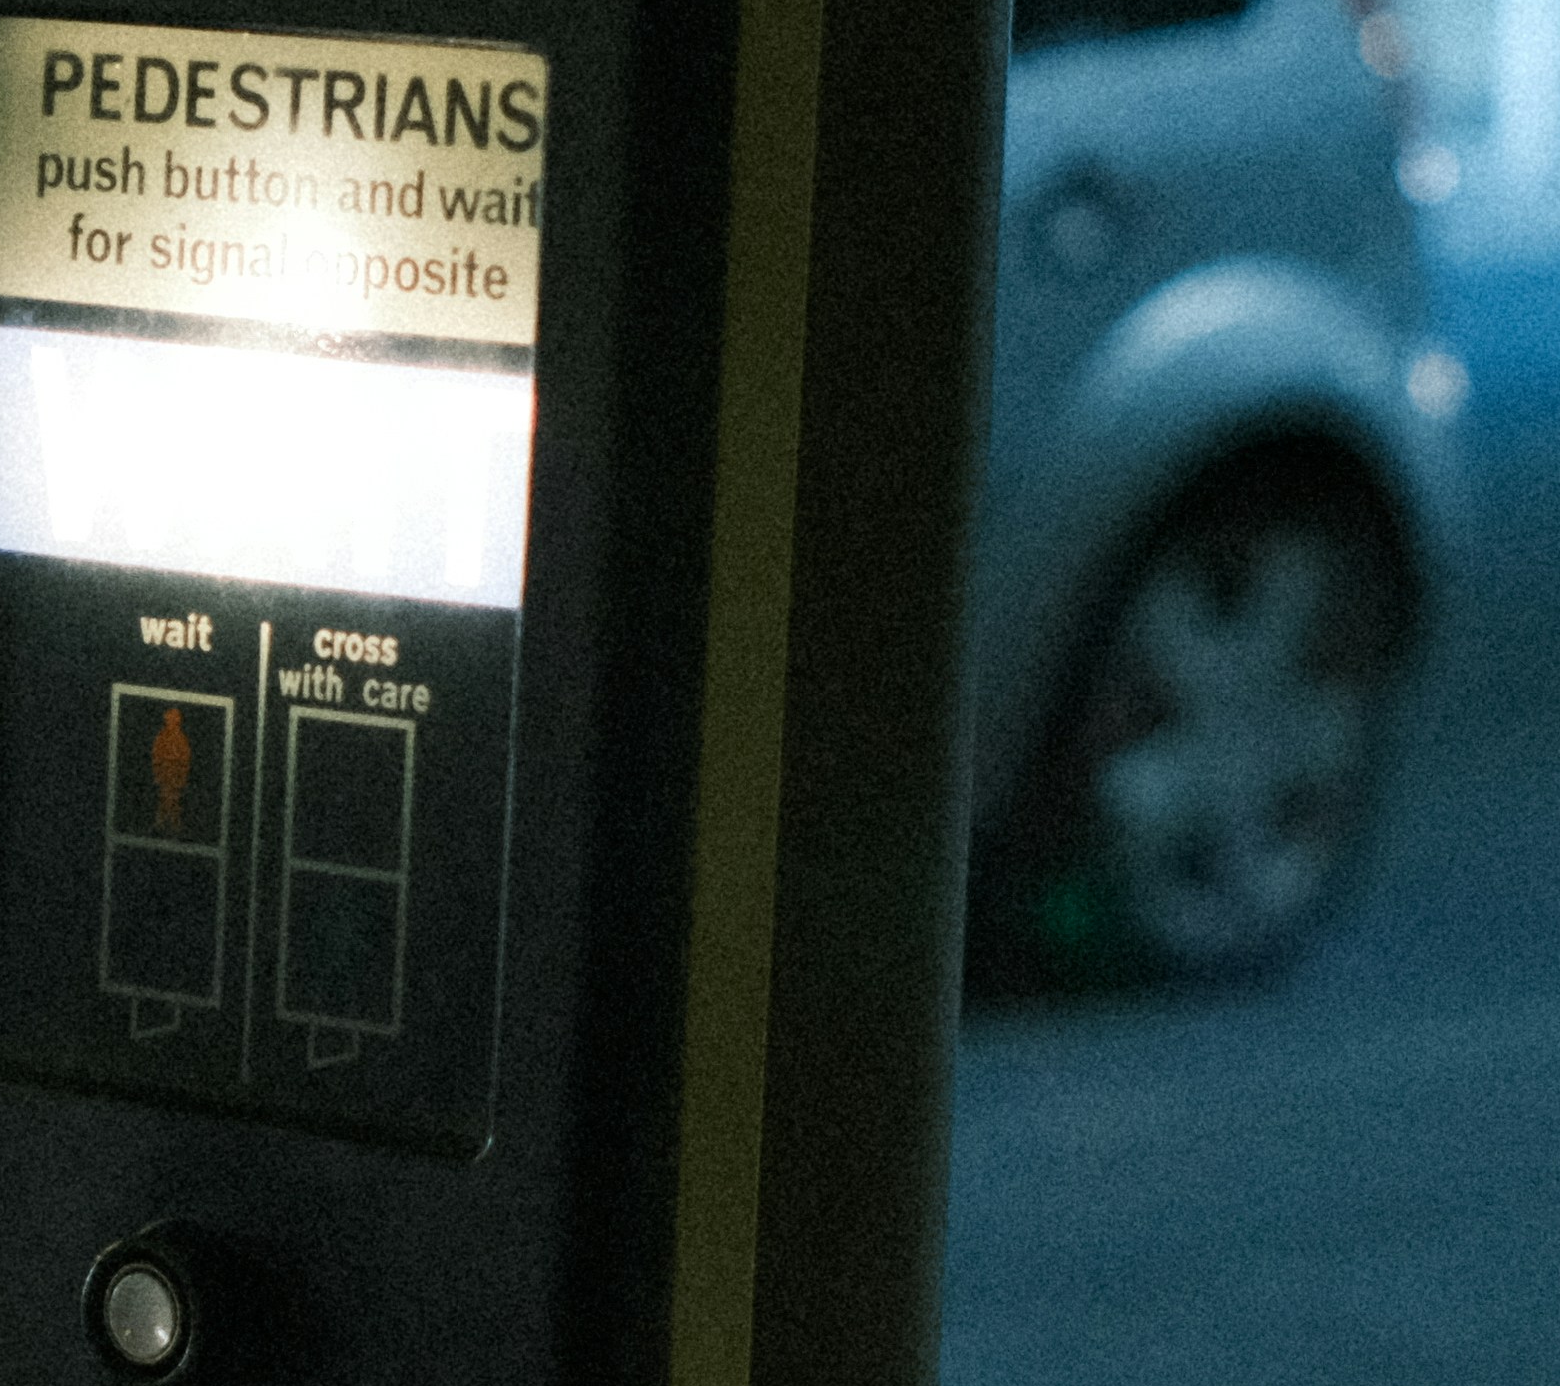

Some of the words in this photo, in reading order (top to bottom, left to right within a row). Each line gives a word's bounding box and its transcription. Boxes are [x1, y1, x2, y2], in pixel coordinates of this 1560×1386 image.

[42, 50, 541, 153] PEDESTRIANS
[37, 146, 144, 198] push
[164, 151, 319, 209] button
[338, 171, 425, 219] and
[440, 176, 540, 227] wait
[68, 213, 133, 265] for
[150, 223, 288, 285] signal
[140, 613, 214, 653] wait
[313, 628, 399, 666] cross
[279, 664, 344, 705] with
[362, 679, 432, 713] care
